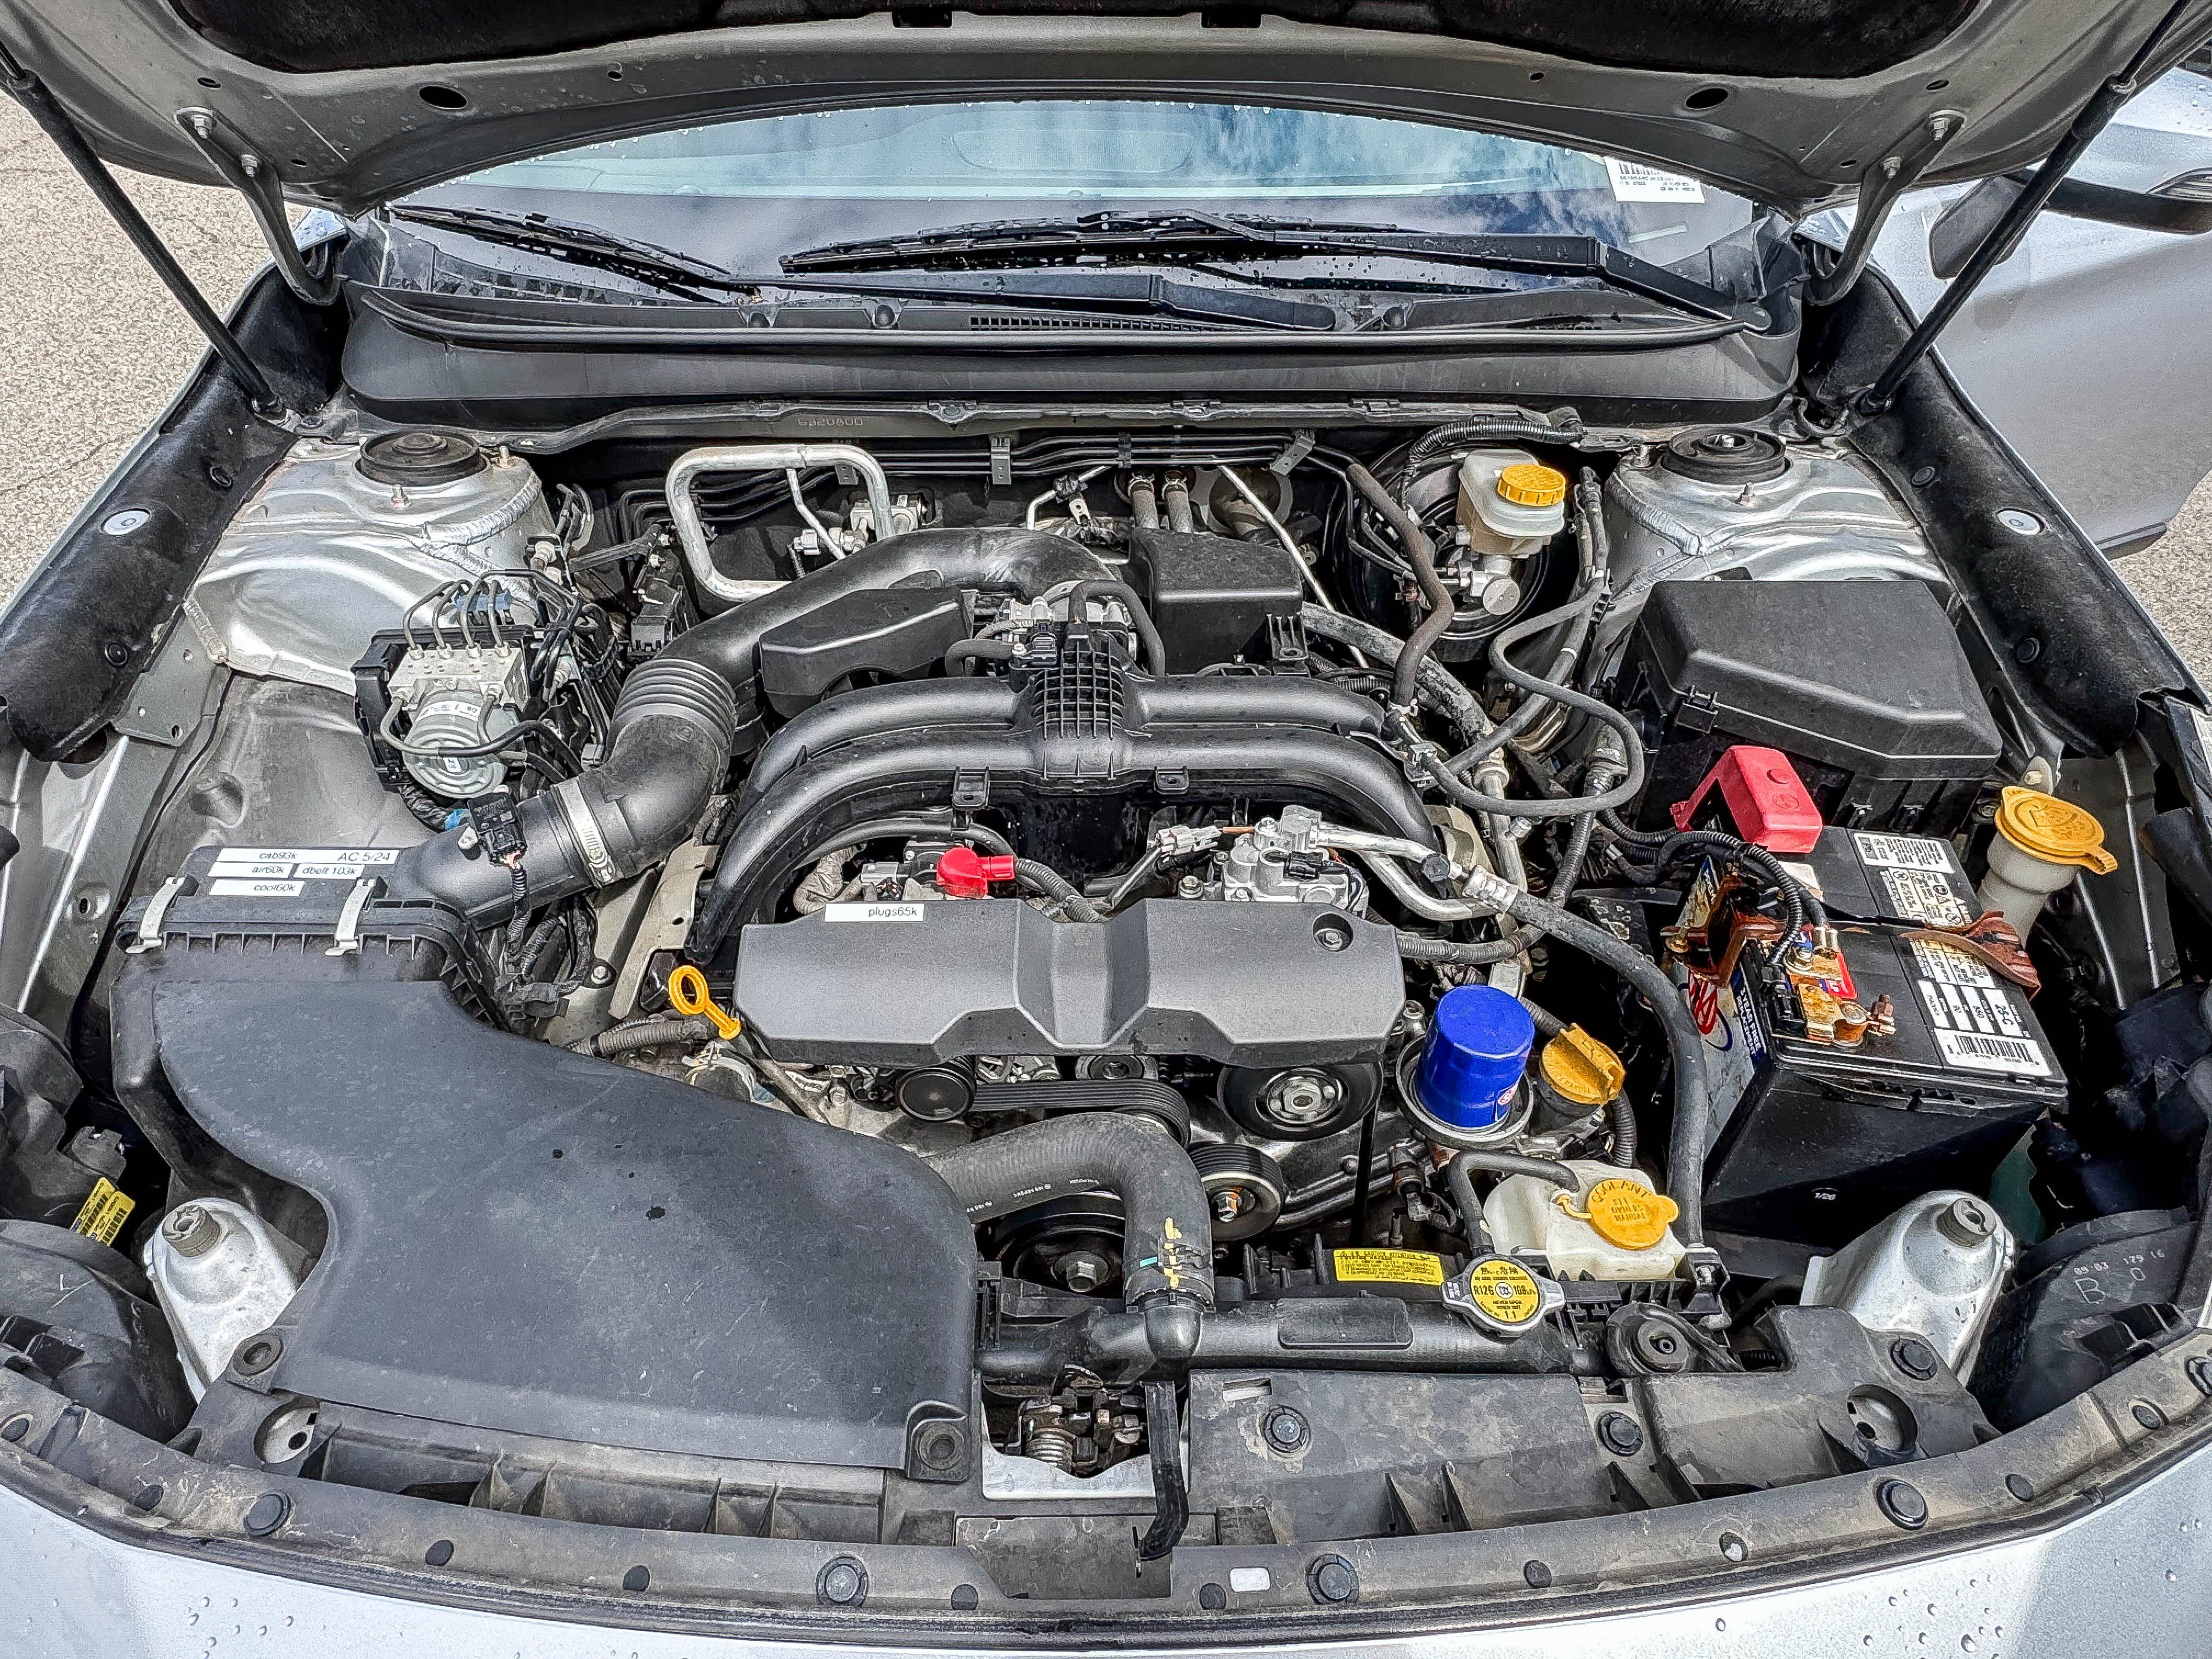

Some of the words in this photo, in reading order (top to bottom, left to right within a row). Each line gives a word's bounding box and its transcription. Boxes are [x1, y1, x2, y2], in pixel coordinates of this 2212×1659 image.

[337, 852, 360, 861] AC
[362, 852, 391, 862] 5/24
[868, 907, 917, 917] plugs65k
[1743, 995, 1753, 1023] YEAR
[1750, 1023, 1762, 1052] FREE
[1592, 1180, 1647, 1203] COOLANT
[1473, 1285, 1494, 1295] R126
